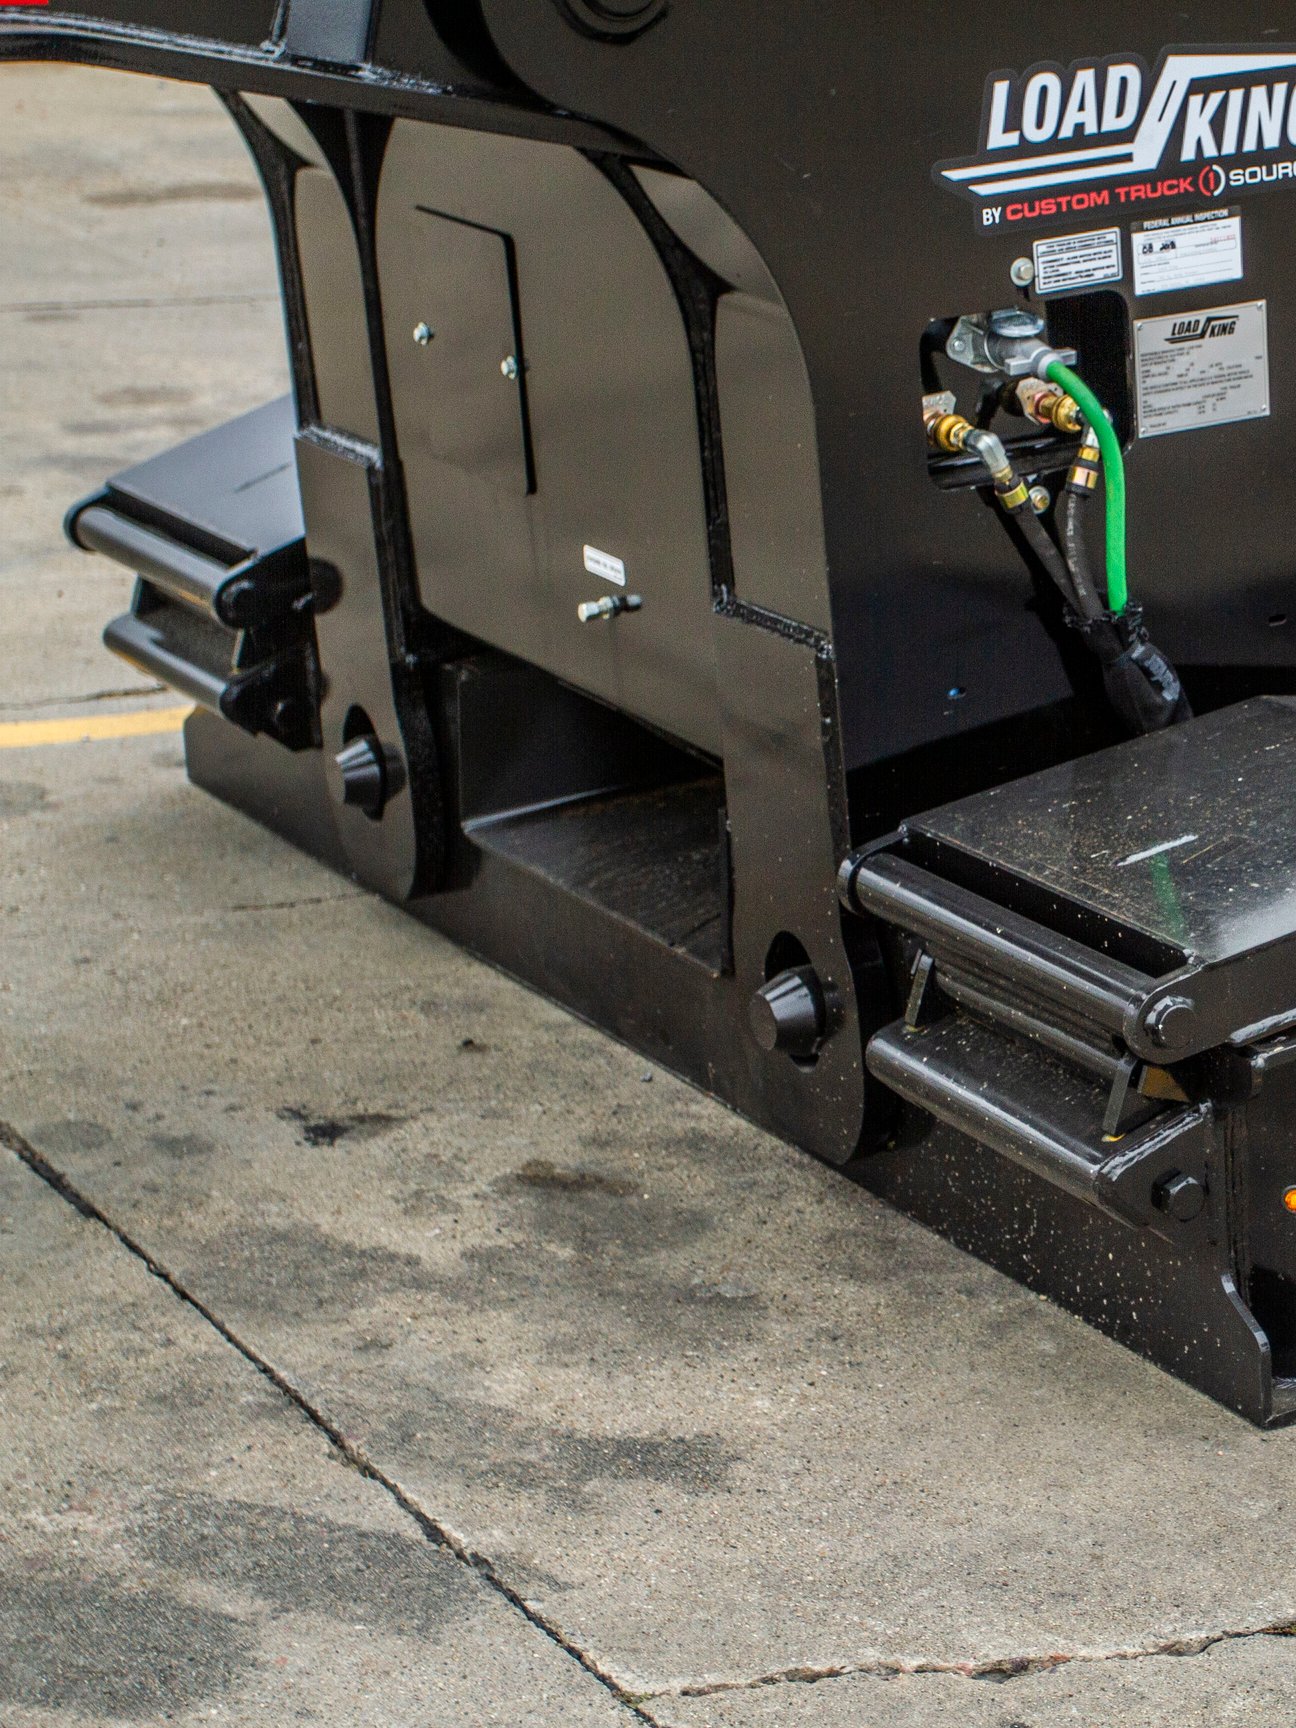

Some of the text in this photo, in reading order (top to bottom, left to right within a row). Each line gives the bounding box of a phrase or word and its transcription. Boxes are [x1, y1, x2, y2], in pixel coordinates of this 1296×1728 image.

[986, 62, 1142, 150] LOAD
[982, 206, 1002, 226] BY
[1005, 191, 1110, 222] CUSTOM
[1114, 176, 1194, 203] TRUCK
[1143, 218, 1170, 231] FEDERAL
[1170, 214, 1193, 226] ANNUAL
[1194, 208, 1229, 222] INSPECTION
[1171, 319, 1237, 338] LOAD KING
